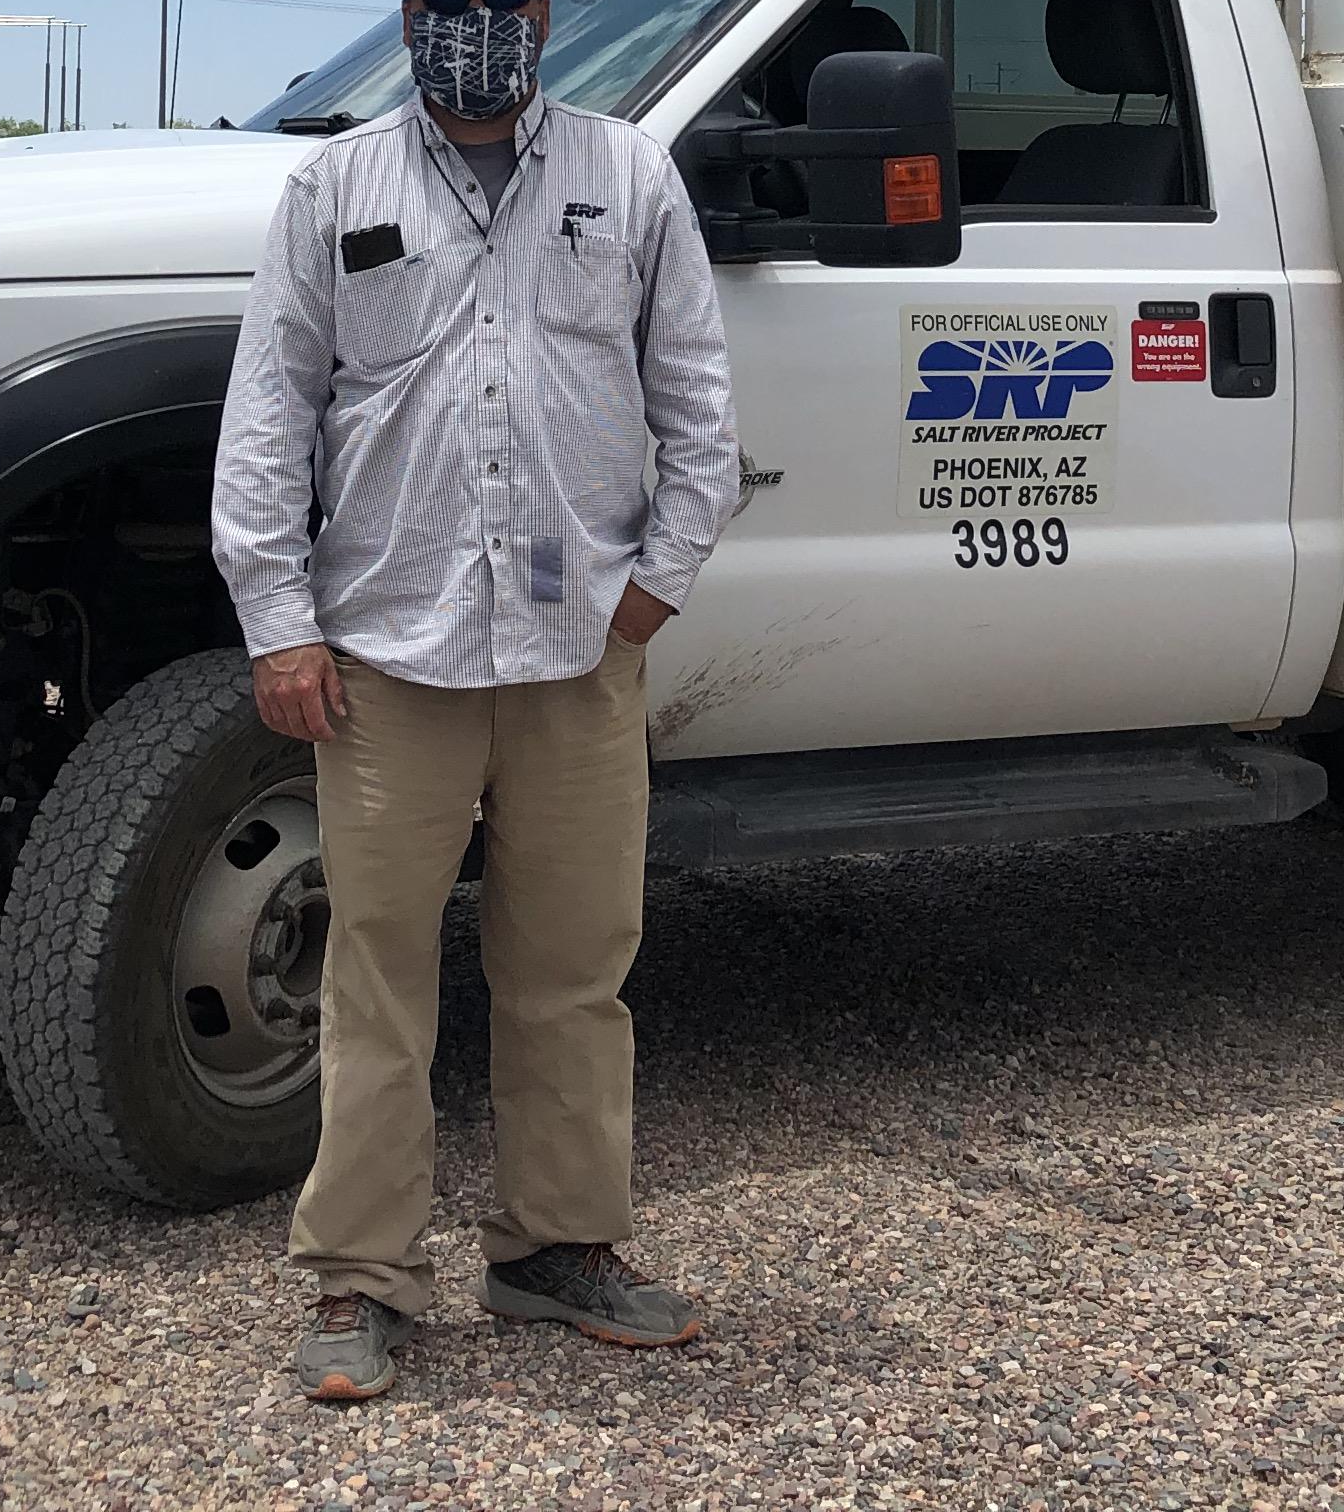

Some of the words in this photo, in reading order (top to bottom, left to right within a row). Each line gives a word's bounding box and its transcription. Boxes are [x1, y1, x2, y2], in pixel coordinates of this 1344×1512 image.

[563, 203, 606, 219] SRP
[911, 314, 947, 332] FOR
[950, 314, 1026, 332] OFFICIAL
[1028, 314, 1062, 331] USE
[1065, 314, 1108, 332] ONLY
[1138, 334, 1199, 348] DANGER!
[1143, 352, 1157, 361] You
[1183, 352, 1195, 361] the
[905, 340, 1114, 420] SRP
[912, 426, 960, 444] SALT
[961, 425, 1021, 443] RIVER
[1021, 424, 1108, 442] PROJECT
[739, 471, 785, 486] ROKE
[933, 456, 1049, 482] PHOENIX,
[1054, 456, 1087, 478] AZ
[919, 486, 953, 509] US
[960, 485, 1013, 508] DOT
[1017, 484, 1098, 507] 876785
[951, 516, 1069, 569] 3989
